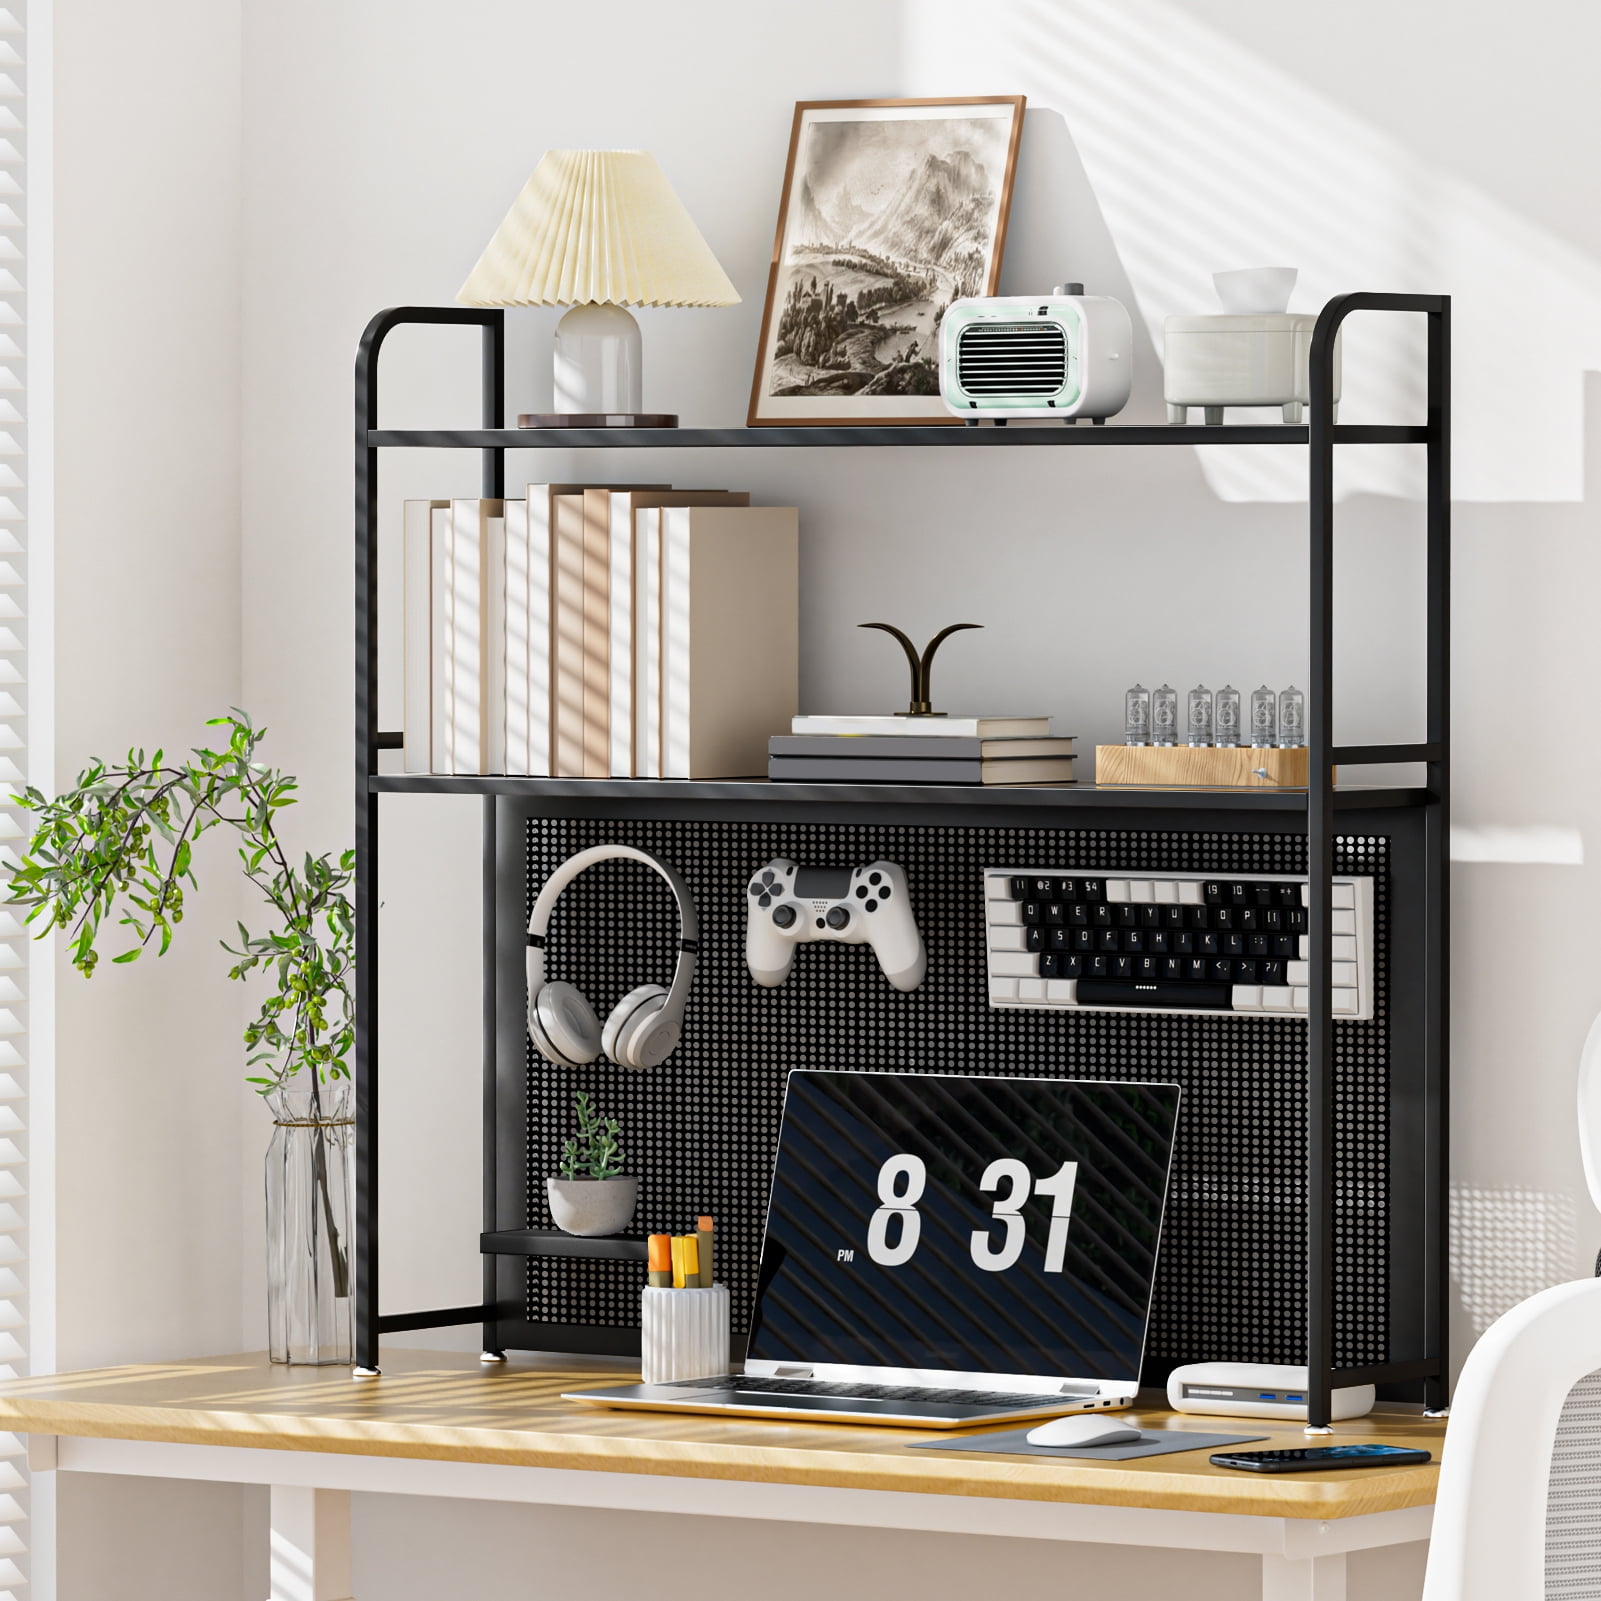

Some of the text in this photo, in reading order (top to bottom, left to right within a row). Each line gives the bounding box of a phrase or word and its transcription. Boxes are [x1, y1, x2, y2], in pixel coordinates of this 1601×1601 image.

[1051, 905, 1058, 915] W
[1076, 906, 1082, 916] E
[1100, 906, 1106, 916] R
[1123, 907, 1129, 917] T
[1148, 908, 1154, 918] Y
[1171, 908, 1178, 918] U
[1244, 910, 1251, 920] P
[1033, 930, 1039, 939] A
[1057, 931, 1064, 940] S
[1106, 931, 1113, 941] F
[1131, 932, 1138, 942] G
[1156, 933, 1163, 943] H
[1205, 935, 1212, 945] K
[1231, 936, 1237, 945] L
[1046, 955, 1052, 966] Z
[1070, 956, 1077, 966] X
[1095, 957, 1101, 967] C
[1119, 958, 1126, 968] V
[1144, 958, 1151, 968] B
[1169, 959, 1176, 969] N
[1193, 959, 1201, 969] M
[837, 1153, 1079, 1273] PM 8 31
